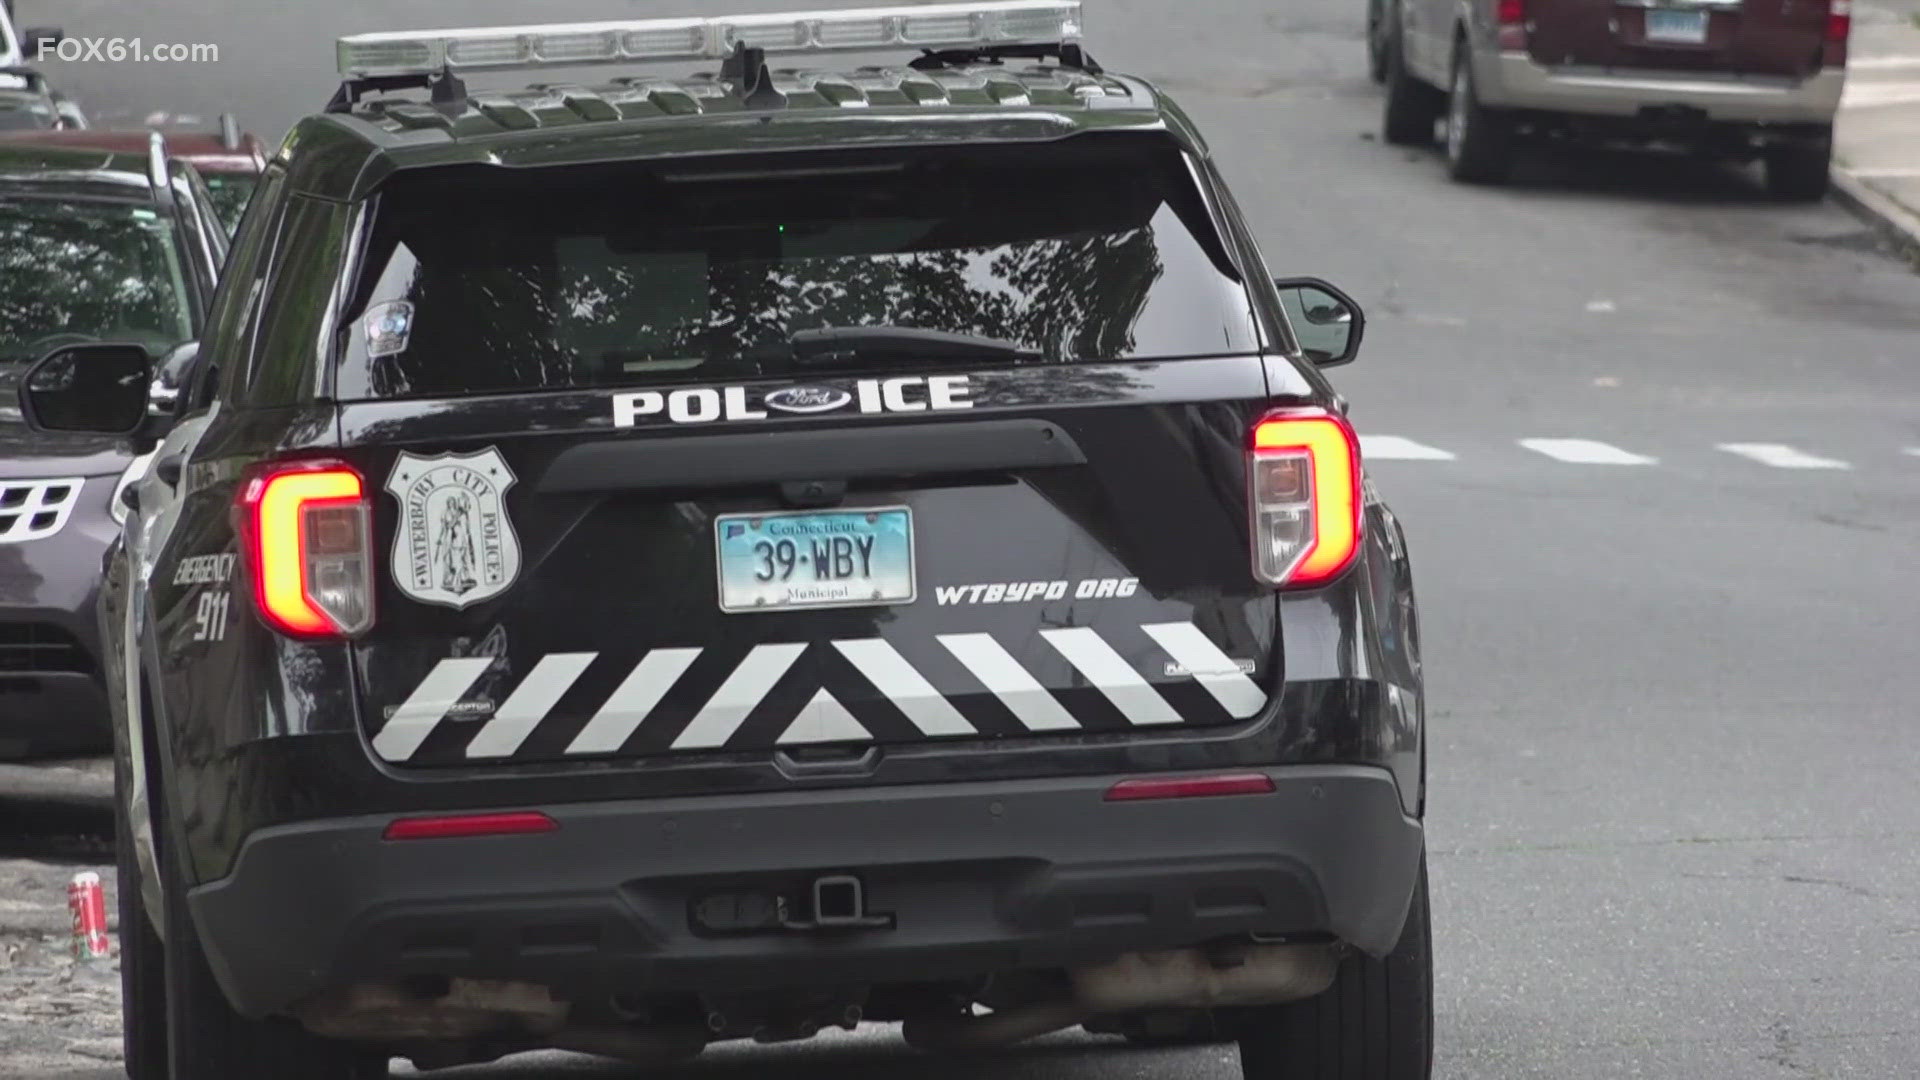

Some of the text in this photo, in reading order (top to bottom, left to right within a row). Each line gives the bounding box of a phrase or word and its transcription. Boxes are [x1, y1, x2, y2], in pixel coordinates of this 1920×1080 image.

[785, 388, 830, 406] Ford
[410, 469, 501, 577] WATERBURY CITY POLICE
[769, 520, 856, 536] Connecticut
[173, 553, 237, 586] EMERGENCY
[787, 586, 849, 600] Municipal
[193, 592, 231, 640] 911
